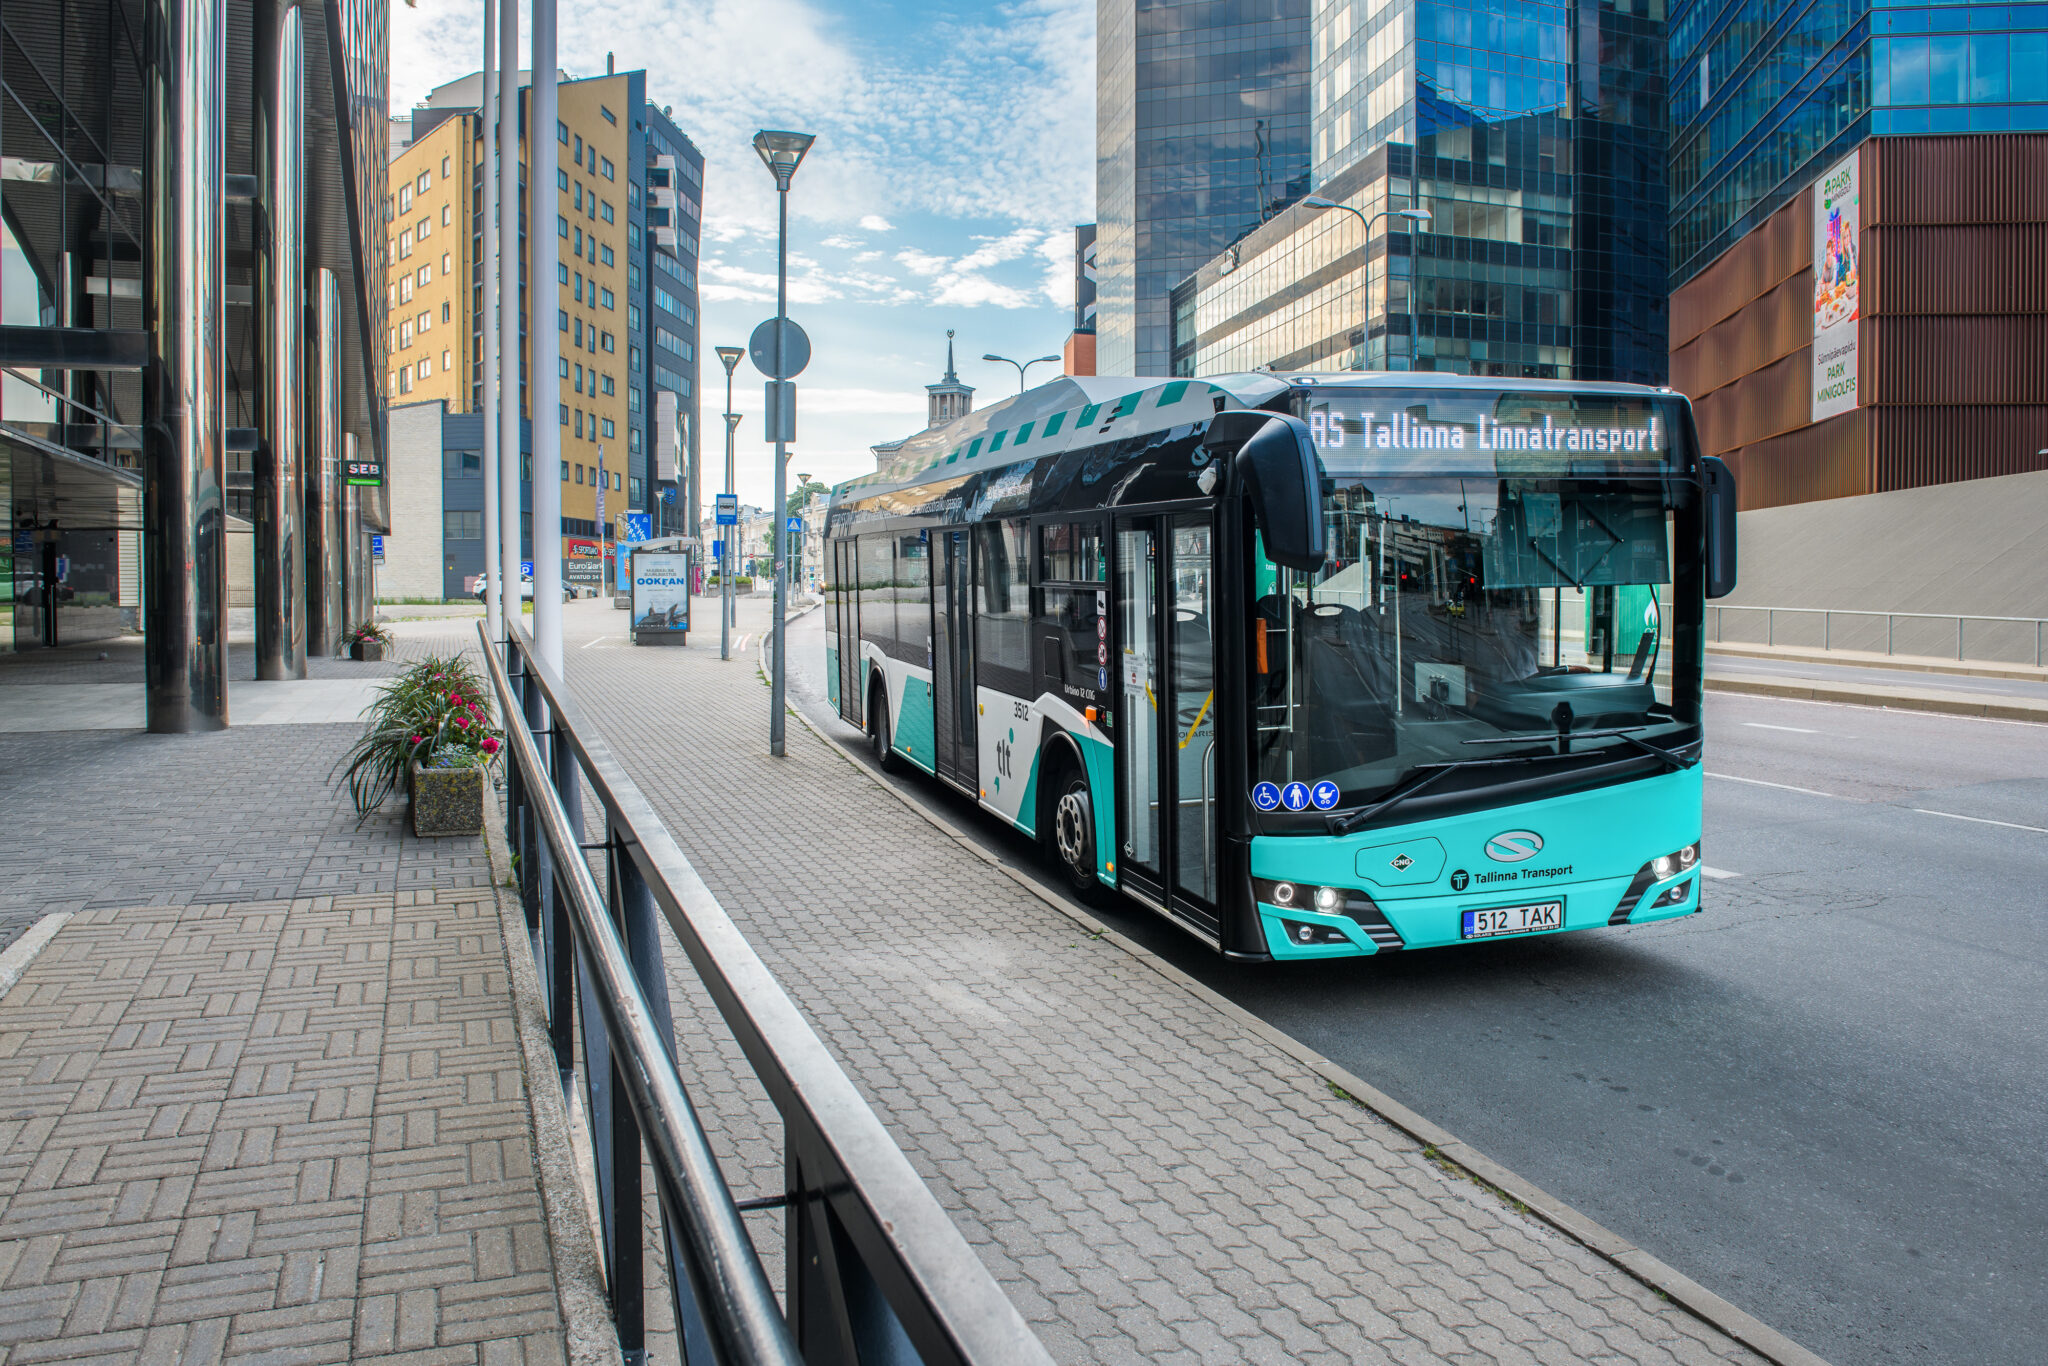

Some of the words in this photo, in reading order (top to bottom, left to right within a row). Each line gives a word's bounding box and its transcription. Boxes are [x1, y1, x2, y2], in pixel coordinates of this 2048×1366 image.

[1832, 166, 1851, 194] PARK
[1827, 360, 1845, 381] PARK
[1816, 376, 1856, 403] MINIGOLFIS
[1310, 411, 1344, 448] AS
[1361, 412, 1465, 449] Tallinna
[1479, 413, 1659, 453] Linnatransport
[348, 463, 380, 475] SEB
[636, 577, 685, 586] OOKEAN
[1064, 684, 1080, 697] Urbino
[1080, 687, 1086, 698] 12
[1085, 688, 1096, 701] CNG
[1014, 701, 1029, 722] 3512
[1178, 730, 1215, 739] OLARIS
[1393, 858, 1411, 867] CNG
[1474, 871, 1518, 884] Tallinna
[1521, 864, 1573, 880] Transport
[1478, 911, 1508, 931] 512
[1520, 905, 1555, 927] TAK
[1464, 925, 1474, 933] EST
